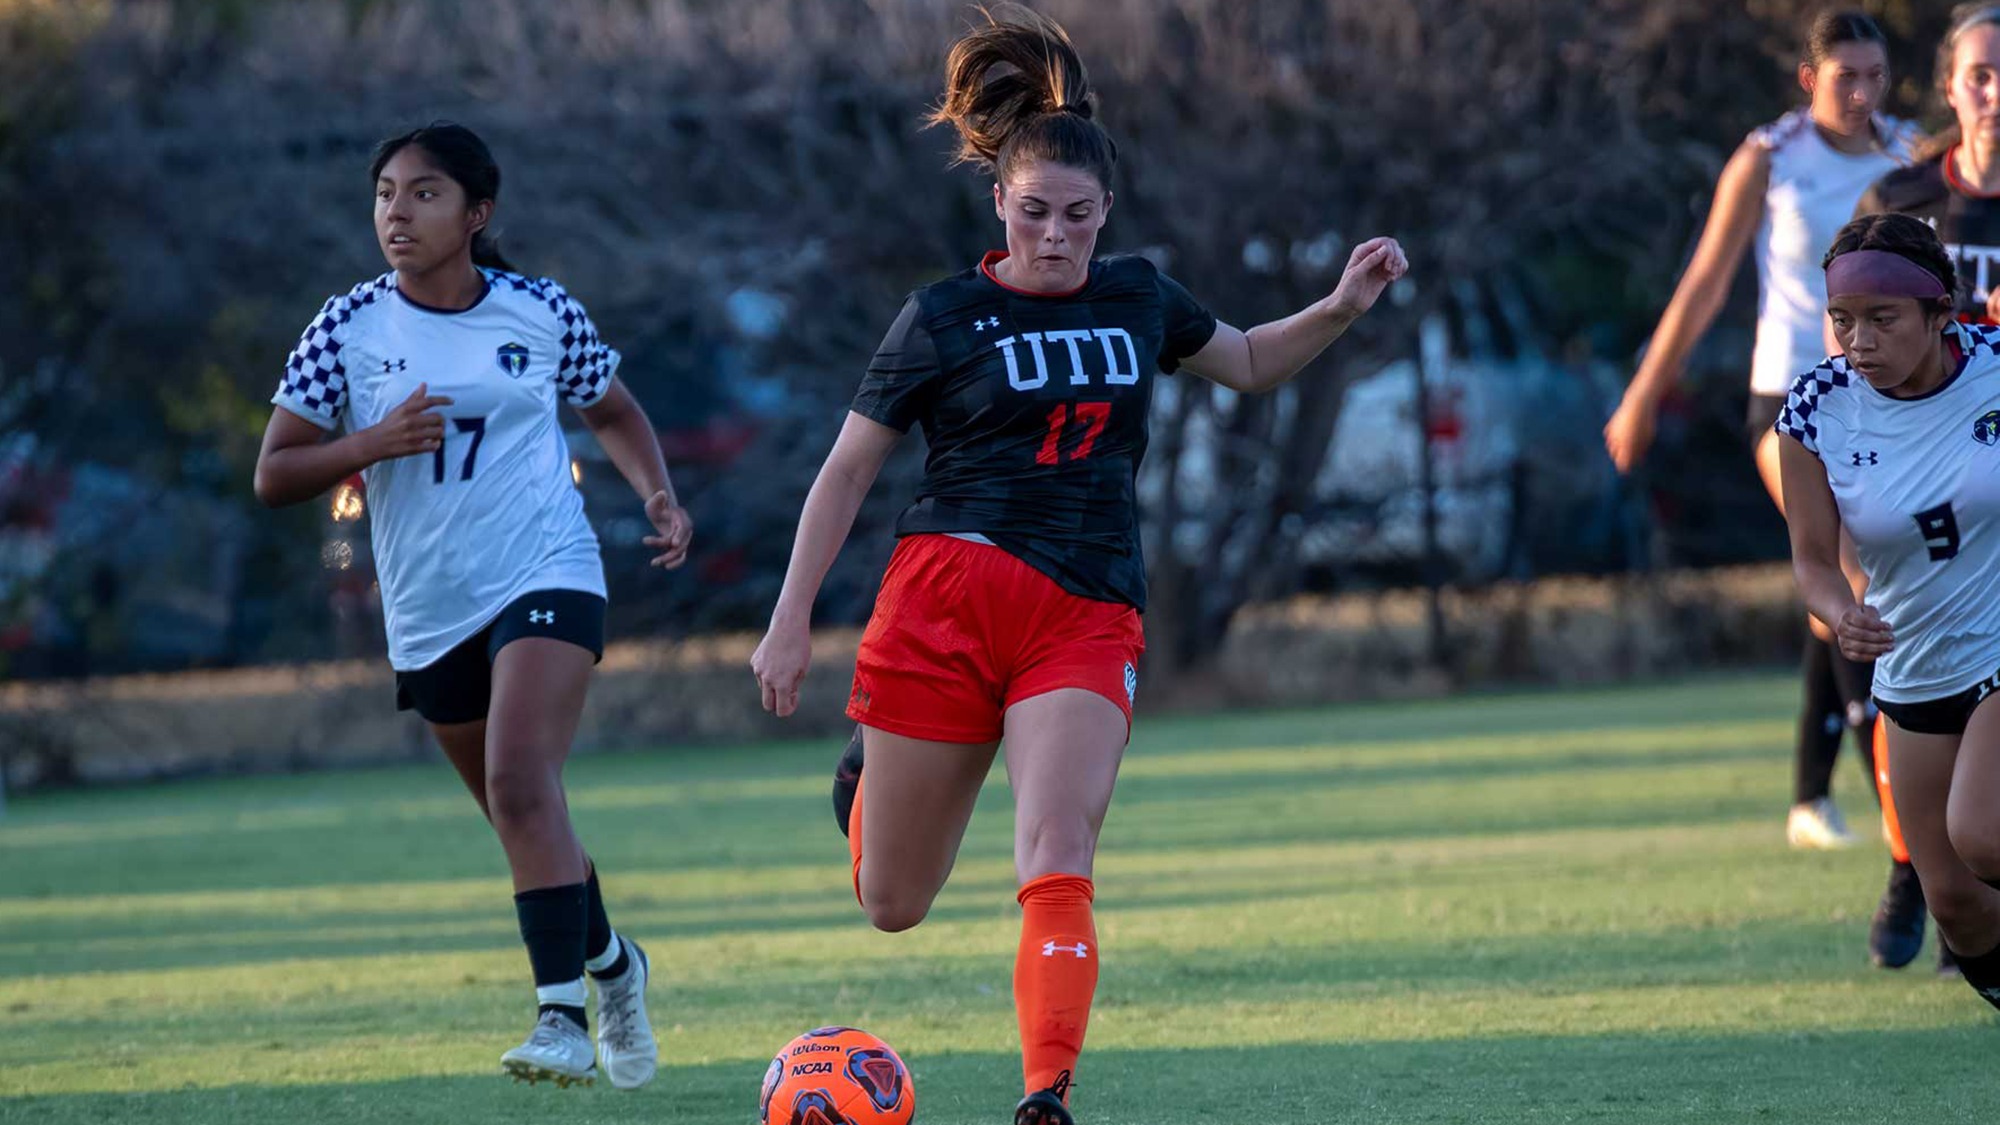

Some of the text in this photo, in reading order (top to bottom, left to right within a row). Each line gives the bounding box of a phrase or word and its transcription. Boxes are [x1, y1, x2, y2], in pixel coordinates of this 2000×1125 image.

[1944, 243, 2000, 303] T
[994, 327, 1139, 392] UTD
[433, 416, 486, 484] 17
[1035, 402, 1112, 465] 17
[1912, 501, 1960, 562] 9
[791, 1043, 840, 1056] Wilson
[791, 1062, 833, 1077] NCAA
